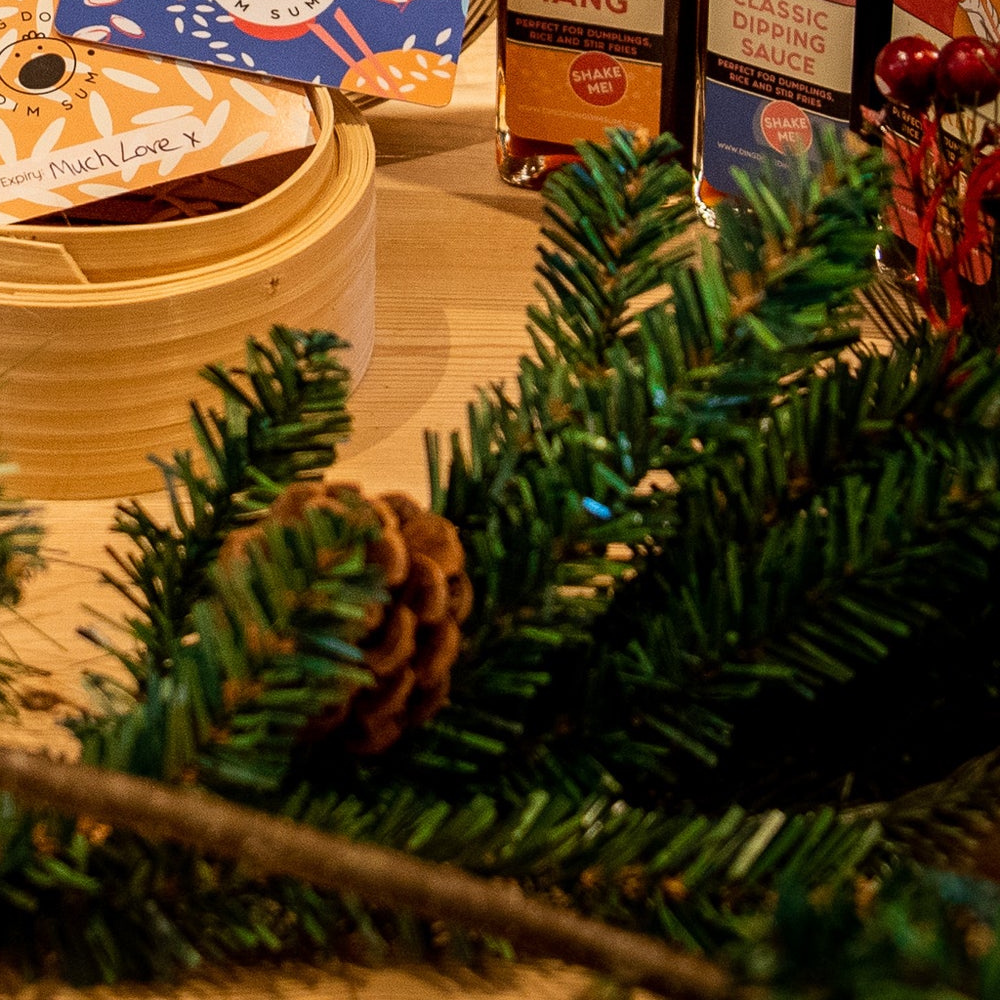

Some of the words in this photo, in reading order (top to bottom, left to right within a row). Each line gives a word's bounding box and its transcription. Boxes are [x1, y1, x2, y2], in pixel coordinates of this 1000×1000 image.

[21, 10, 51, 22] DO
[515, 17, 559, 31] PERFECT
[562, 25, 584, 36] FOR
[587, 28, 653, 48] DUMPLINGS,
[732, 10, 826, 54] DIPPING
[530, 31, 553, 42] RICE
[556, 35, 580, 46] AND
[584, 39, 605, 50] STIR
[608, 43, 638, 55] FRIES
[741, 37, 815, 76] SAUCE
[61, 71, 99, 111] SUM
[572, 66, 622, 83] SHAKE
[587, 82, 613, 95] ME!
[718, 58, 755, 77] PERFECT
[757, 70, 776, 83] FOR
[778, 76, 835, 102] DUMPLINGS,
[729, 72, 749, 86] RICE
[752, 80, 772, 93] AND
[775, 86, 794, 100] STIR
[796, 93, 822, 108] FRIES
[764, 117, 808, 129] SHAKE
[49, 149, 119, 180] Much
[120, 137, 182, 163] Love
